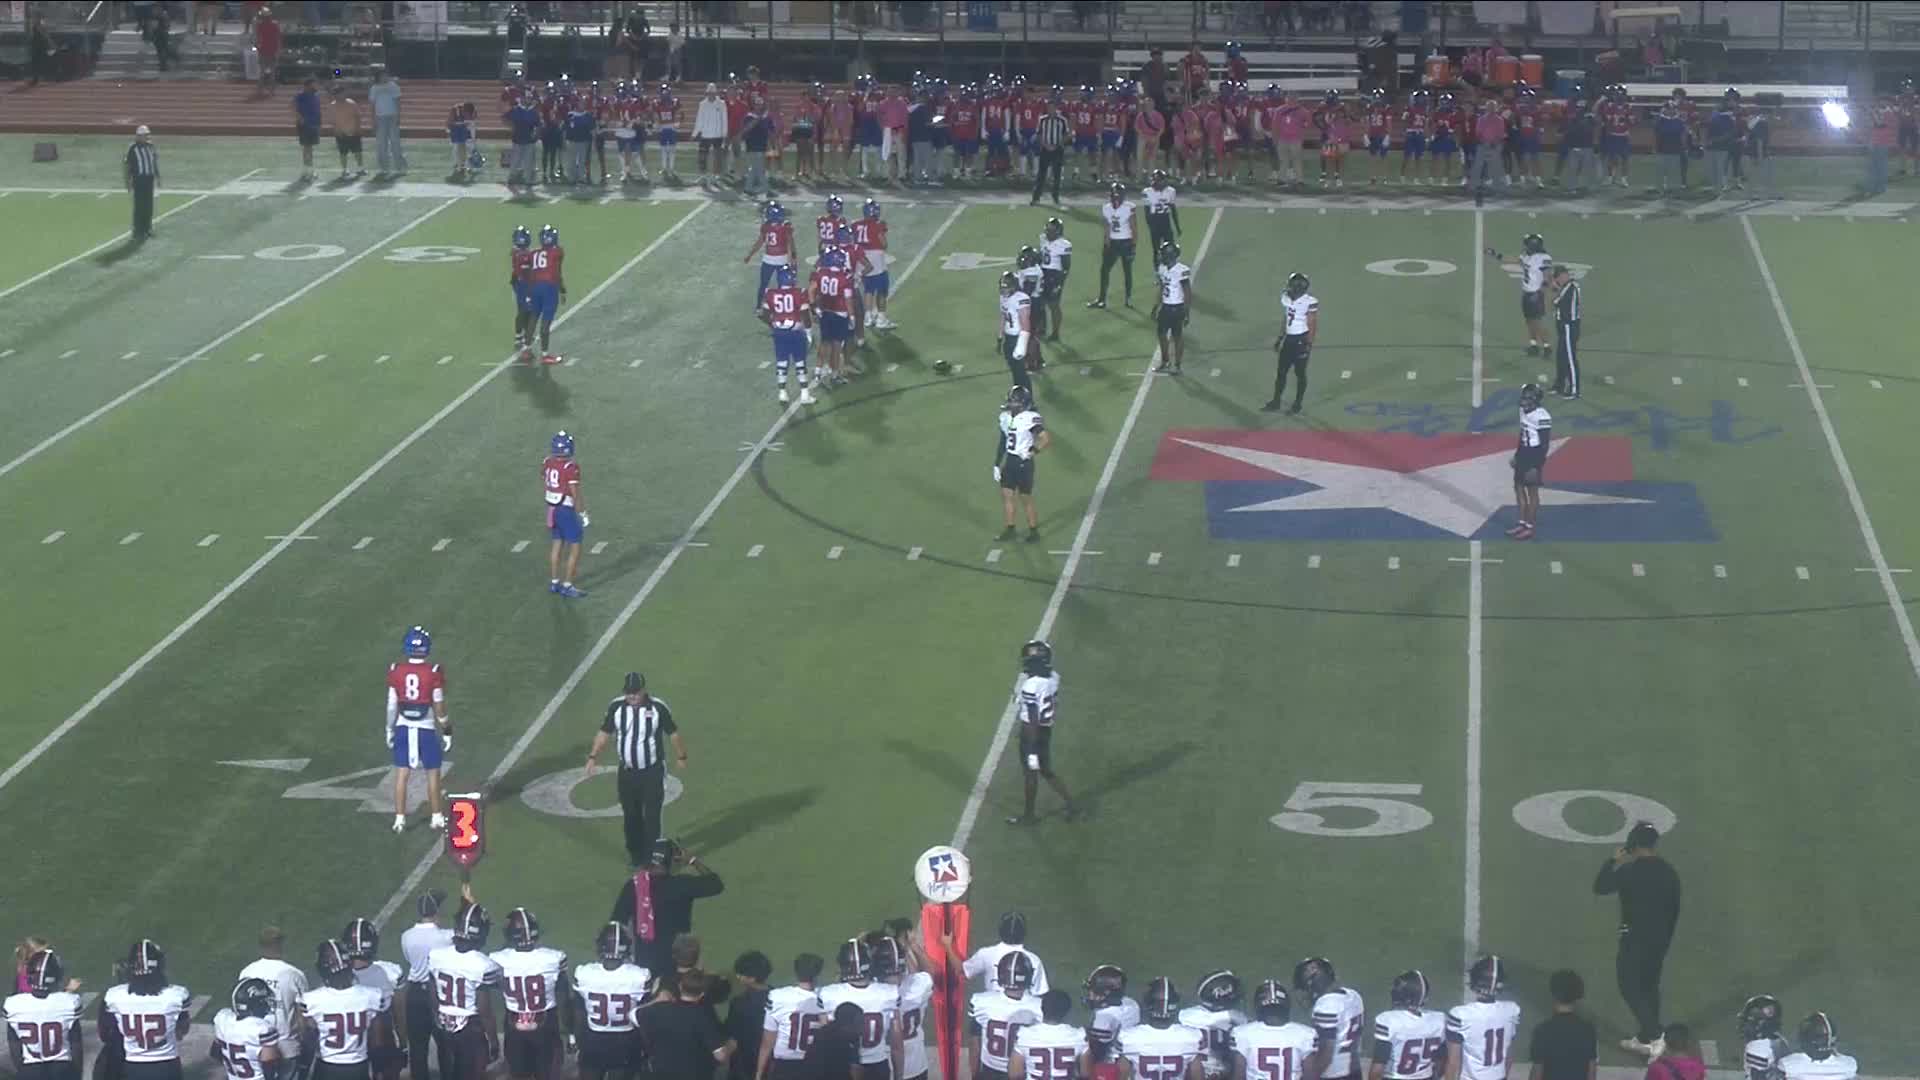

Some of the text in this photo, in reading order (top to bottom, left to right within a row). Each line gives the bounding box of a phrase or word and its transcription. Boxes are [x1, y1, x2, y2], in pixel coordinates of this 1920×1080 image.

[533, 251, 547, 269] 16
[774, 294, 794, 313] 50
[820, 276, 838, 296] 60
[405, 673, 419, 700] 8
[452, 802, 478, 848] 3
[438, 972, 466, 1008] 31
[504, 975, 546, 1012] 48
[588, 992, 631, 1027] 33
[18, 1022, 63, 1057] 20
[122, 1014, 166, 1050] 42
[323, 1011, 367, 1050] 34
[1483, 1028, 1504, 1066] 11
[1029, 1048, 1075, 1080] 35
[1258, 1047, 1293, 1080] 51
